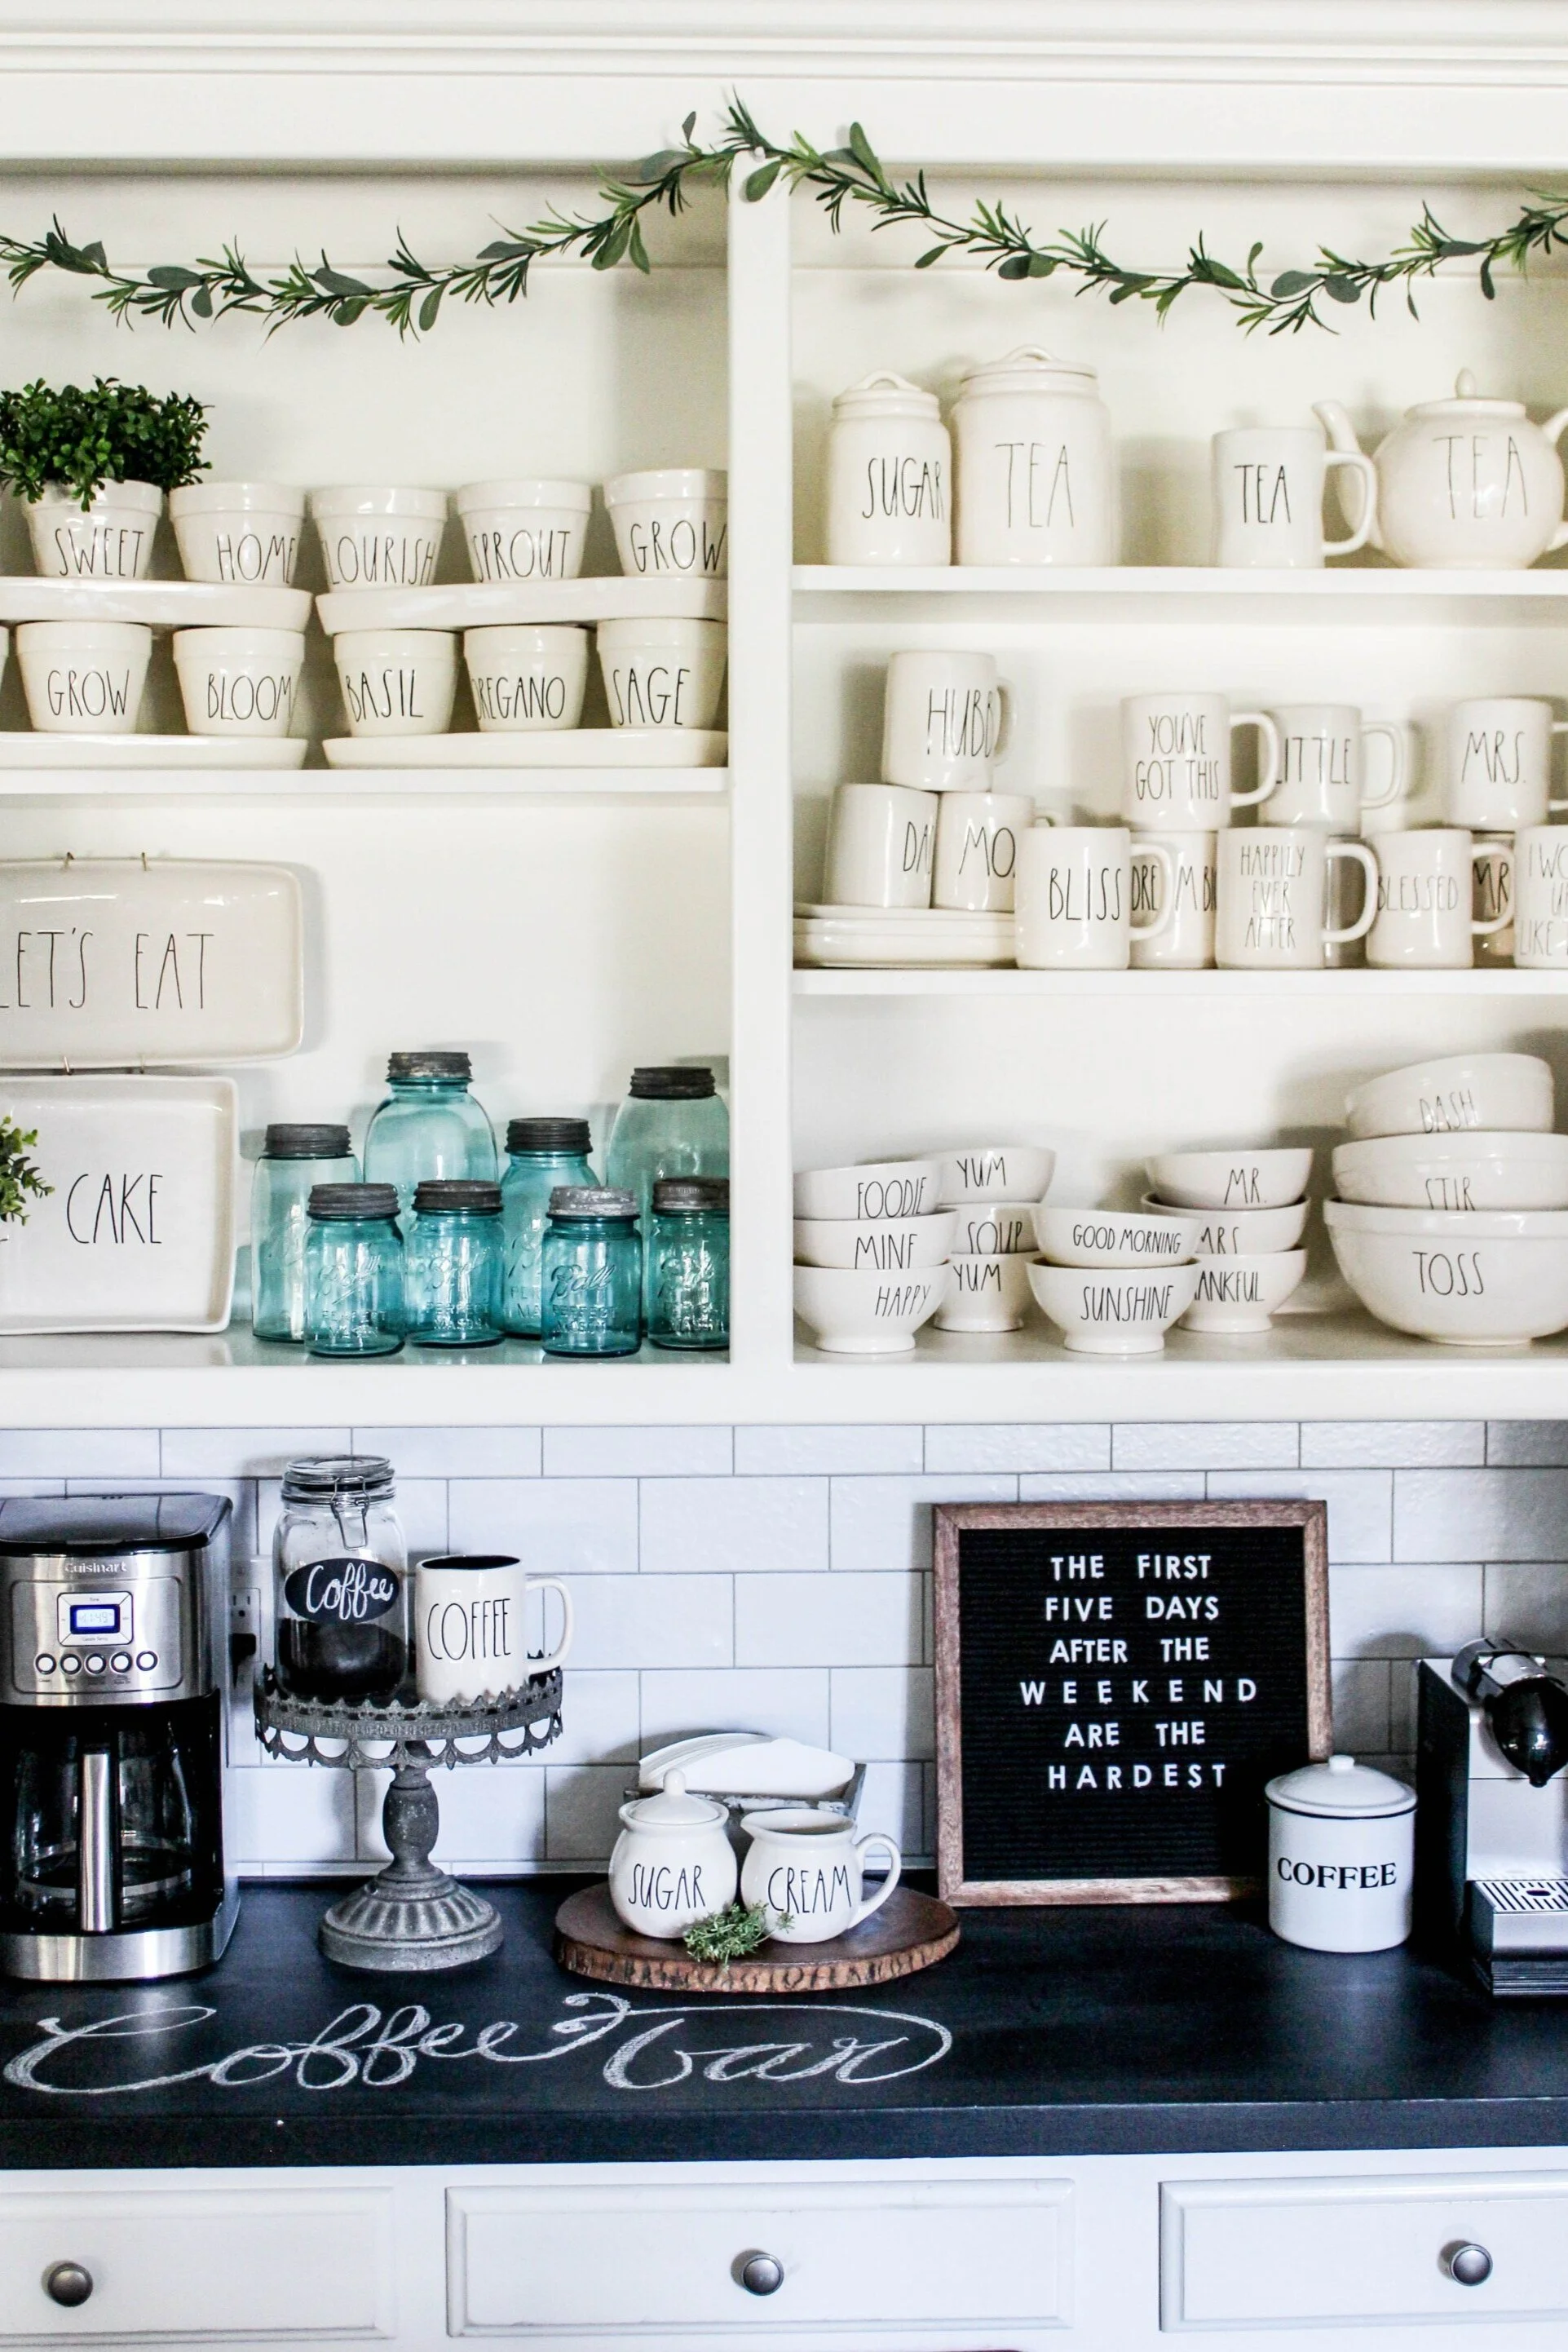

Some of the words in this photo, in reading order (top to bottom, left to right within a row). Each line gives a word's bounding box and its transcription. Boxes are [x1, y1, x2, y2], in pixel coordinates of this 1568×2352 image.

[863, 458, 944, 522] SUGAR
[995, 443, 1074, 528] TEA
[1234, 465, 1291, 524] TEA
[1433, 435, 1527, 519] TEA
[55, 528, 144, 577] SWEET
[217, 534, 295, 584] HOME
[321, 536, 436, 585] LOURISH
[630, 520, 727, 573] GROW
[47, 670, 129, 716] GROW
[208, 674, 292, 720] BLOOM
[346, 670, 423, 722] BASIL
[612, 667, 690, 725] SAGE
[1149, 712, 1206, 754] YOU'VE
[1136, 760, 1174, 799] GOT
[1186, 760, 1219, 800] THIS
[1276, 737, 1351, 784] ITTLE
[903, 821, 934, 875] DA
[958, 826, 1015, 878] MO
[1240, 845, 1305, 878] HAPPILY
[1049, 869, 1122, 921] BLISS
[1131, 864, 1197, 911] DREM
[1252, 881, 1292, 913] EVER
[1377, 875, 1459, 912] BLESSED
[1245, 917, 1296, 948] AFTER
[1520, 919, 1553, 956] LIKE
[0, 927, 93, 1008] ET'S
[135, 934, 214, 1010] EAT
[1420, 1089, 1479, 1134] DASH
[956, 1156, 1006, 1188] YUM
[1224, 1168, 1267, 1205] MR.
[1425, 1176, 1476, 1211] STIR
[67, 1174, 163, 1244] CAKE
[858, 1177, 926, 1219] FOODIE
[968, 1221, 1023, 1254] SOUP
[1073, 1224, 1115, 1250] GOOD
[1119, 1228, 1182, 1254] MORNING
[550, 1264, 616, 1302] Ball
[953, 1264, 1001, 1292] YUM
[1194, 1270, 1265, 1302] ANKFUL
[1412, 1251, 1484, 1295] TOSS
[875, 1284, 931, 1317] HAPPY
[1080, 1285, 1174, 1322] SUNSHINE
[65, 1561, 128, 1574] Cuisinart
[1050, 1554, 1104, 1581] THE
[1137, 1554, 1211, 1580] FIRST
[306, 1563, 394, 1620] Coffee
[1045, 1597, 1113, 1622] FIVE
[1146, 1596, 1219, 1620] DAYS
[427, 1598, 511, 1660] COFFEE
[1049, 1638, 1128, 1664] AFTER
[1160, 1637, 1210, 1663] THE
[1019, 1678, 1257, 1705] WEEKEND
[1064, 1722, 1120, 1749] ARE
[1155, 1721, 1206, 1747] THE
[1049, 1763, 1226, 1789] HARDEST
[628, 1863, 706, 1910] SUGAR
[767, 1864, 852, 1914] CREAM
[1277, 1856, 1398, 1890] COFFEE
[3, 1992, 629, 2093] Coffee
